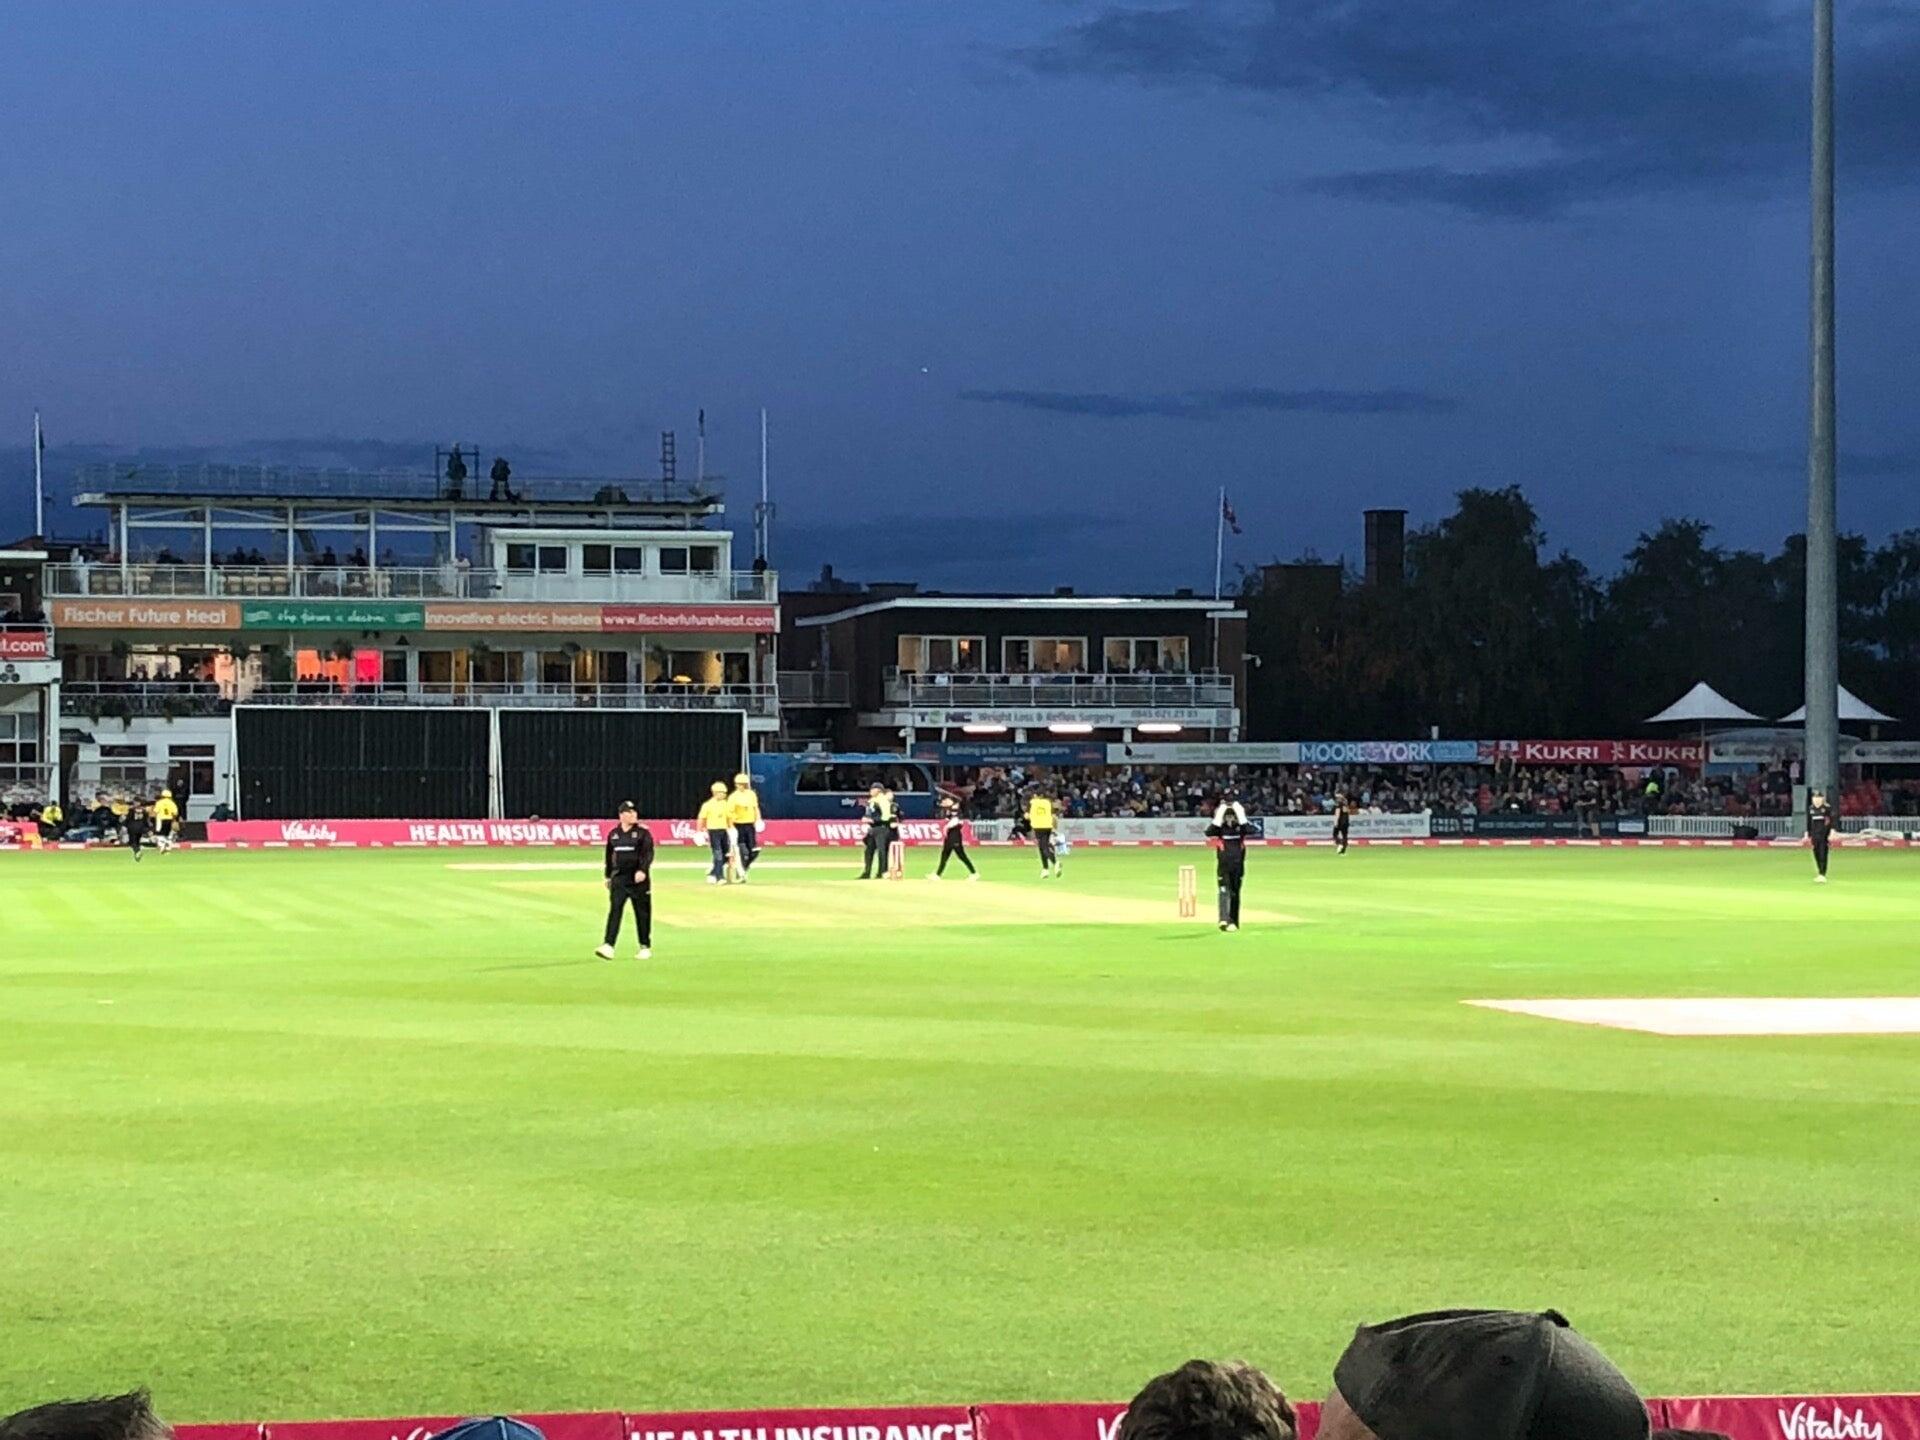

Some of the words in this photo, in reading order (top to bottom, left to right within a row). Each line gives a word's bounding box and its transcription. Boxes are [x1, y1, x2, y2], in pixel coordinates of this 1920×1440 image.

[63, 607, 123, 622] Fischer
[128, 608, 181, 623] Future
[186, 609, 226, 624] Heat
[498, 612, 549, 625] electric
[1302, 743, 1365, 761] MOORE
[1381, 743, 1432, 761] YORK
[1525, 743, 1599, 760] KUKRI
[1630, 744, 1704, 760] KUKRI
[281, 821, 337, 840] Vitality
[409, 824, 485, 841] HEALTH
[490, 824, 602, 841] INSURANCE
[818, 824, 942, 840] INVESENTS
[1778, 1401, 1883, 1440] Vitality
